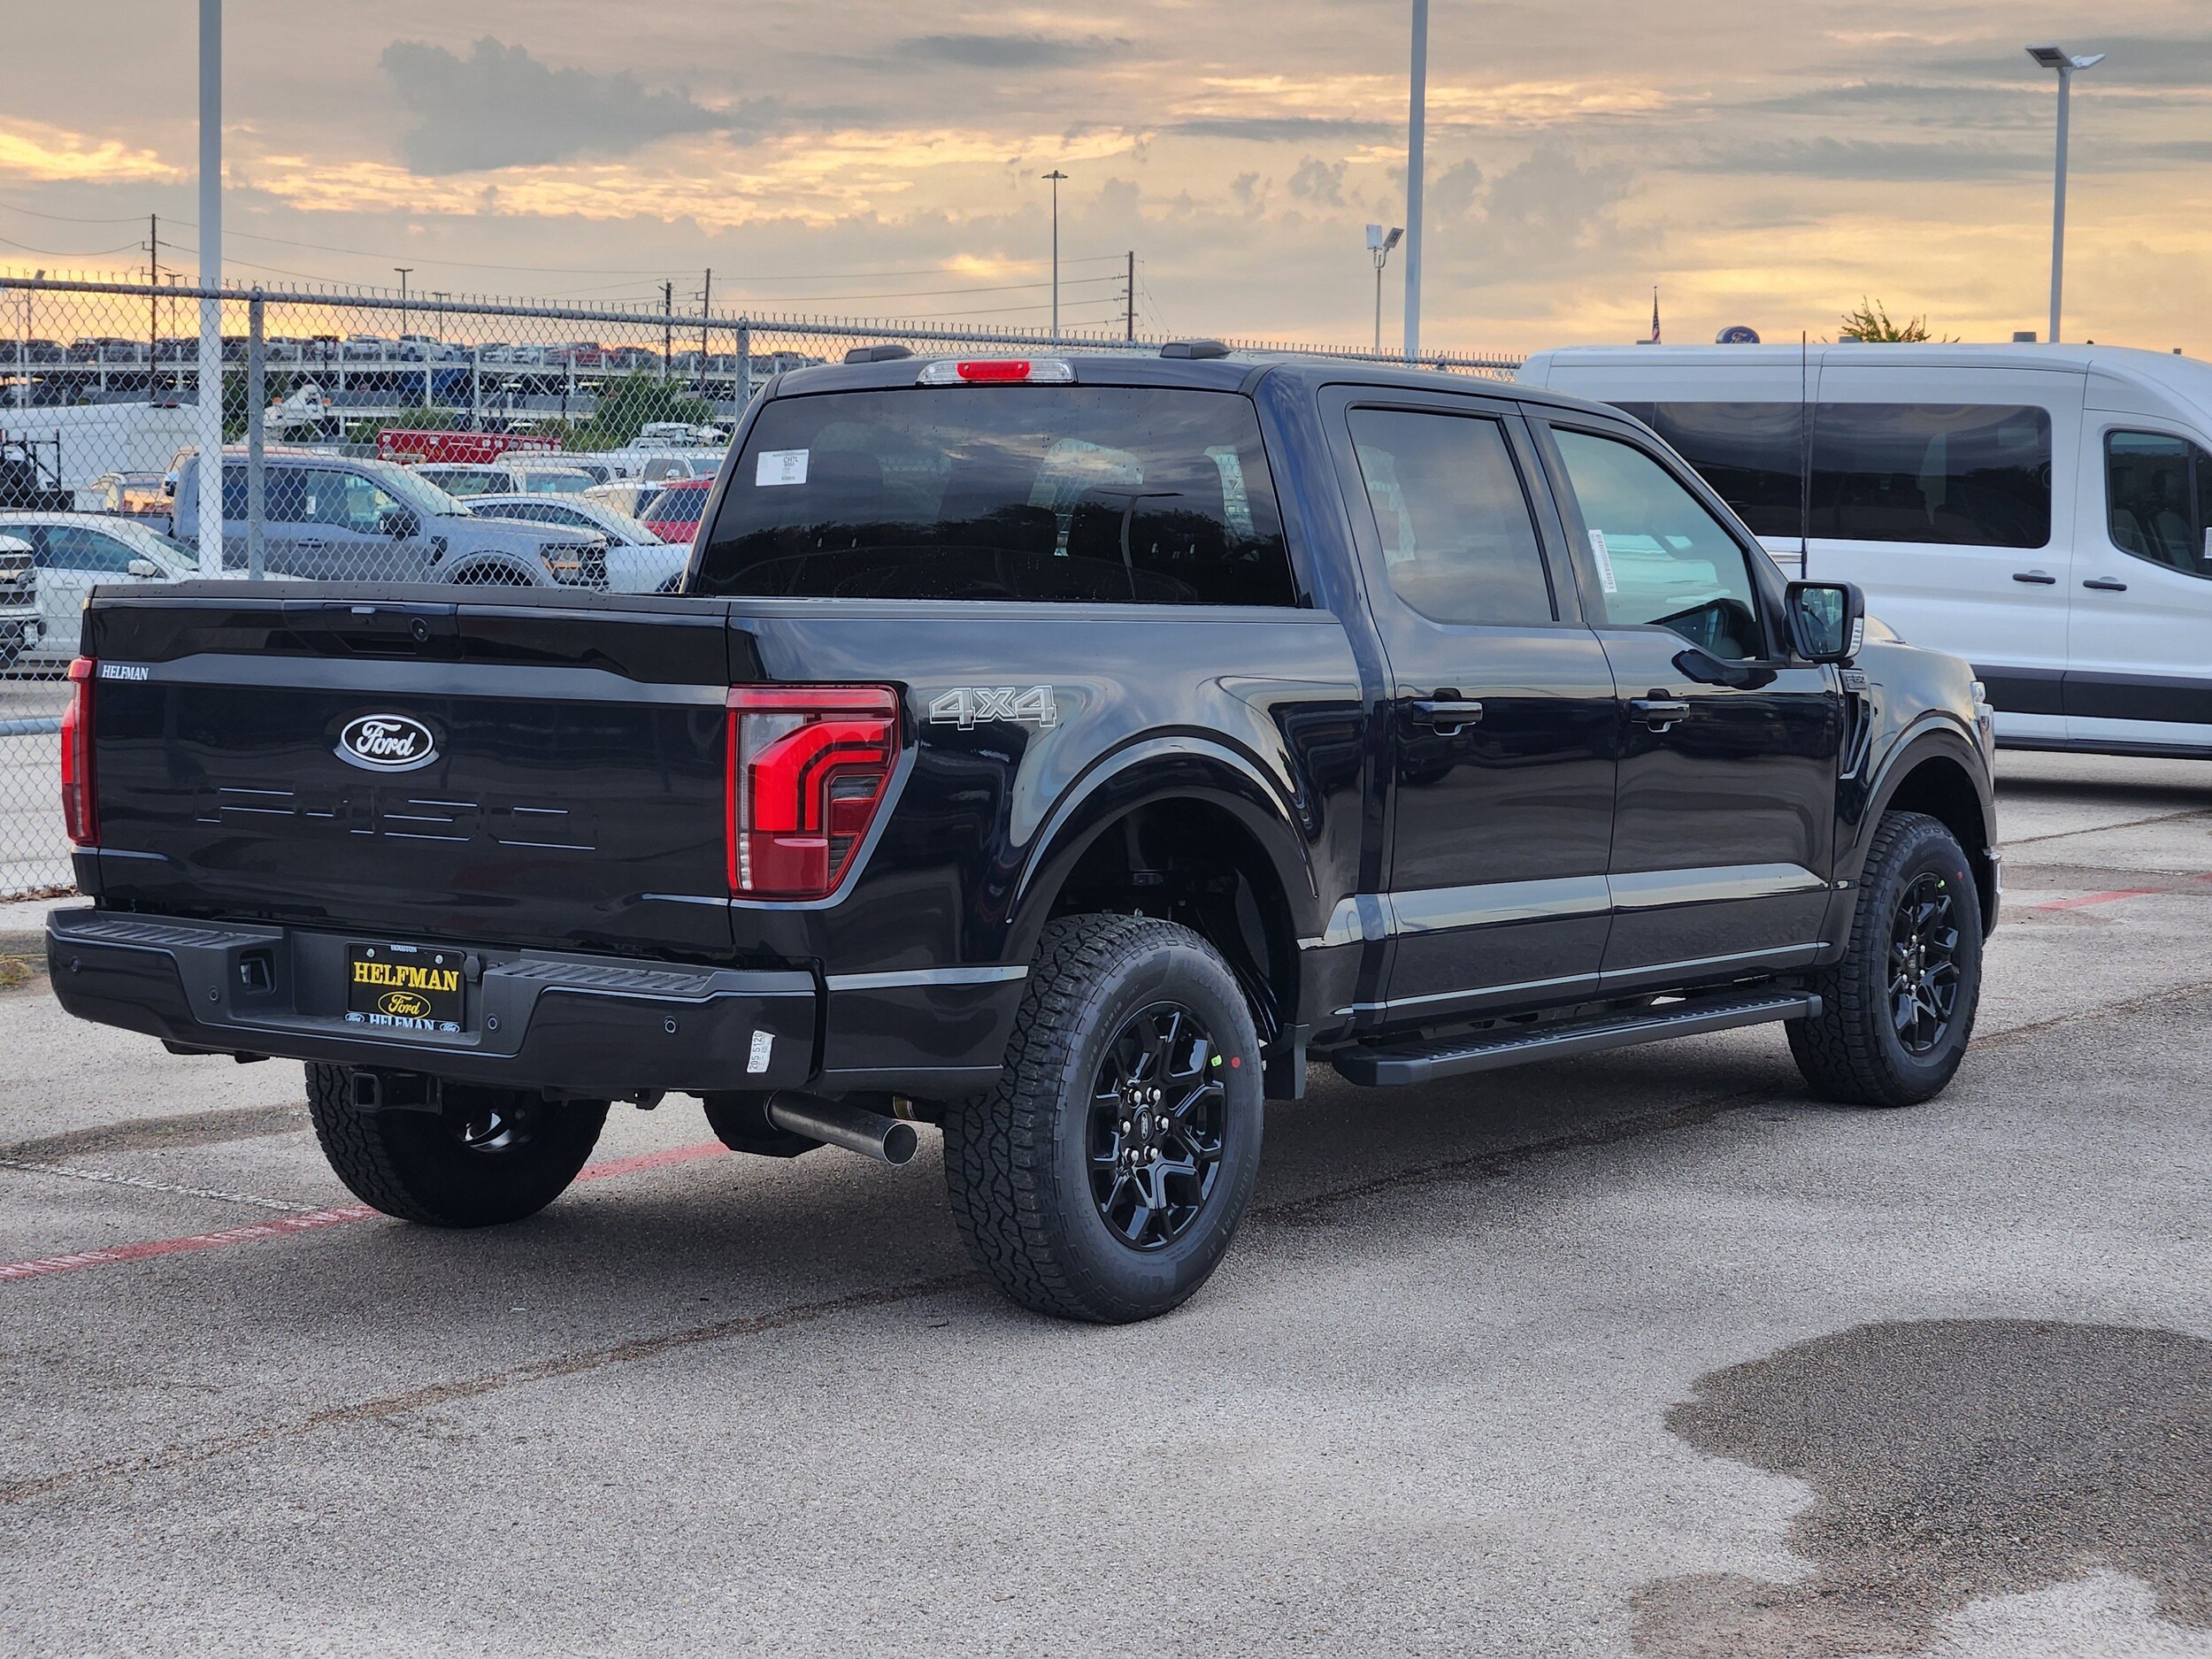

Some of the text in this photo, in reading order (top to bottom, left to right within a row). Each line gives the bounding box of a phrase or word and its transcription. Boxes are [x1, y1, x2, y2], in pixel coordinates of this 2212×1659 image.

[102, 664, 150, 681] HELFMAN
[356, 720, 417, 757] Ford
[353, 961, 460, 992] HELFMAN
[388, 994, 420, 1015] Ford
[368, 1013, 435, 1031] HELFMAN
[749, 1033, 762, 1069] 205 5120
